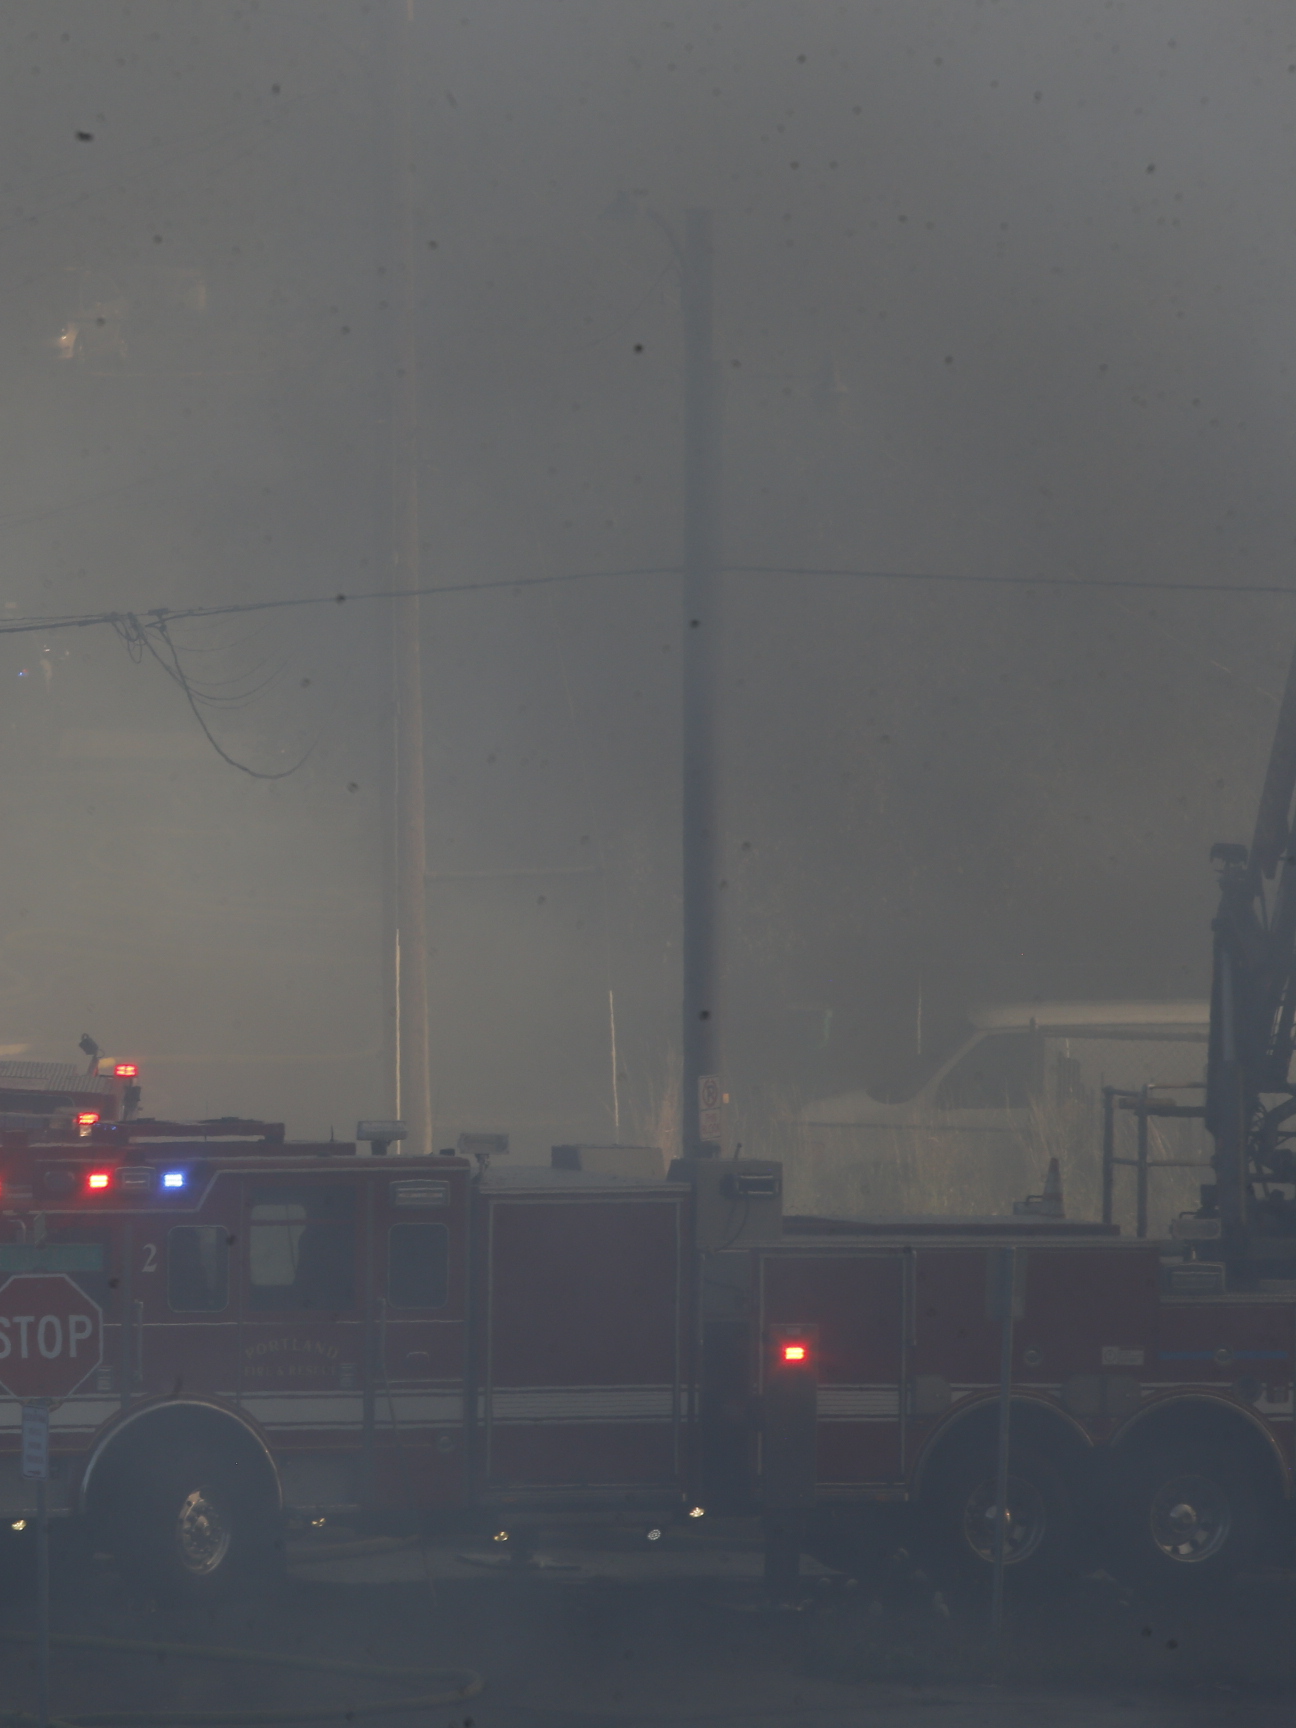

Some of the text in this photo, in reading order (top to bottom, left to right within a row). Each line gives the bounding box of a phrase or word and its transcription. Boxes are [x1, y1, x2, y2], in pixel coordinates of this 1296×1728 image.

[142, 1243, 158, 1272] 2
[244, 1338, 341, 1360] PORTLAND
[244, 1365, 273, 1376] FIRE
